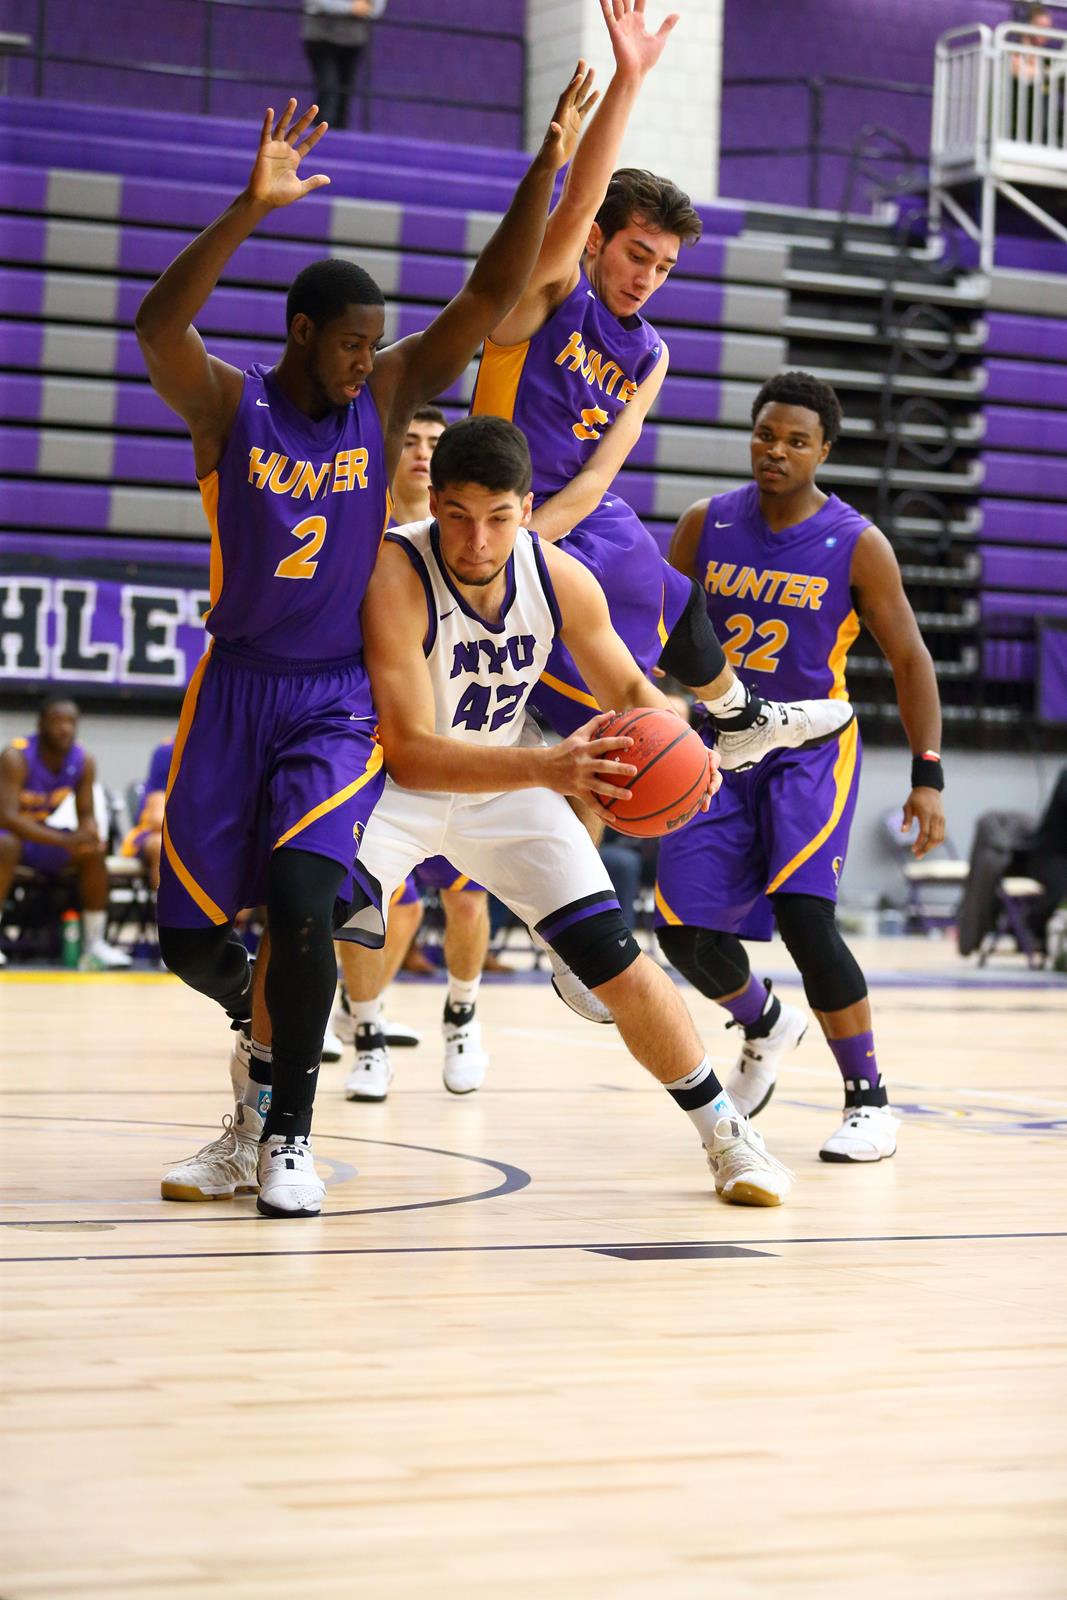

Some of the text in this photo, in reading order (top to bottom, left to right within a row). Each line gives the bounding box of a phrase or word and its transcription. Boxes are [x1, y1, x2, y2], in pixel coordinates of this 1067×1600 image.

[554, 331, 638, 405] HUNTE
[274, 515, 327, 579] 2
[704, 560, 829, 611] HUNTER
[0, 576, 212, 687] HLE
[450, 634, 537, 679] NYU
[720, 613, 789, 673] 22
[451, 681, 529, 732] 42
